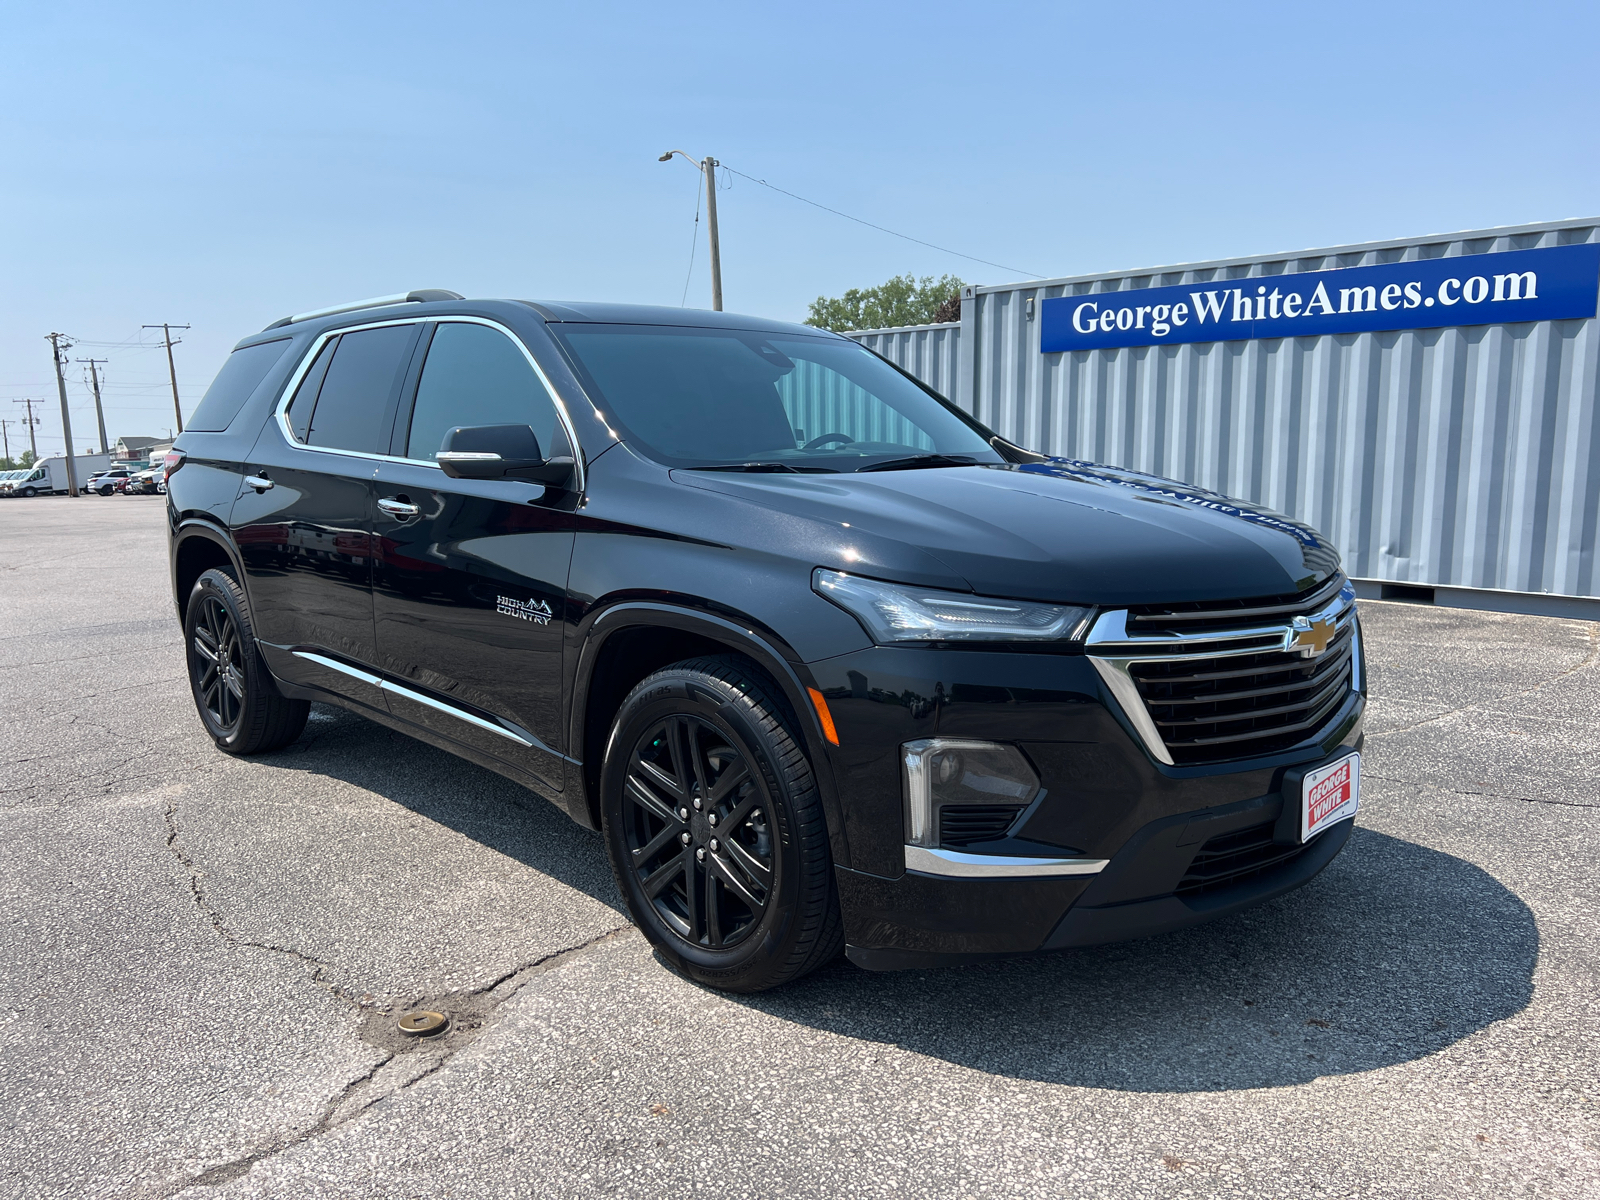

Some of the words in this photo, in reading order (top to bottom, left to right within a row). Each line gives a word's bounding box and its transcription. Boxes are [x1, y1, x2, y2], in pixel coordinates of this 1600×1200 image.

[1072, 270, 1538, 337] GeorgeWhiteAmes.com
[496, 595, 525, 610] HIGH
[496, 604, 551, 626] COUNTRY
[1310, 765, 1348, 805] GEORGE
[1313, 787, 1342, 822] WHITE
